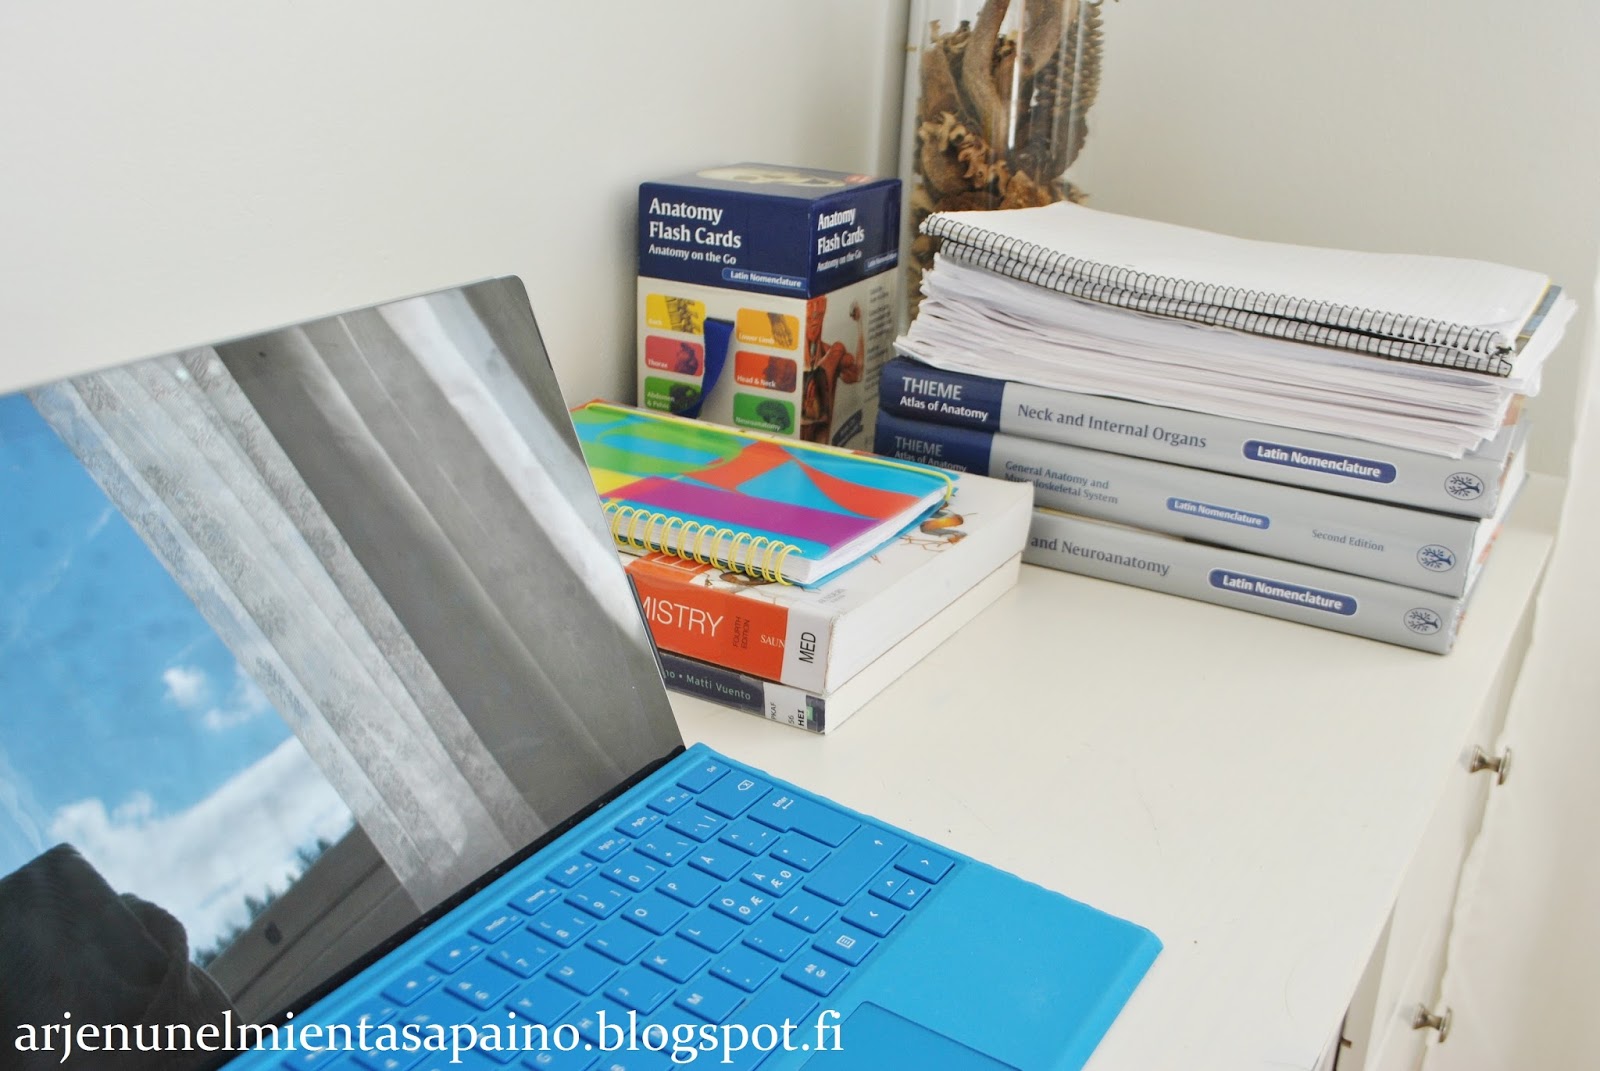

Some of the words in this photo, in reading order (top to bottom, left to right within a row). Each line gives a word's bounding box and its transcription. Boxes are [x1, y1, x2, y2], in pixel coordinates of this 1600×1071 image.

[648, 197, 724, 226] Anatomy
[817, 207, 856, 231] Anatomy
[649, 221, 691, 243] Flash
[695, 227, 742, 249] Cards
[817, 233, 841, 255] Flash
[841, 225, 865, 248] Cards
[648, 244, 690, 260] Anatomy
[691, 251, 704, 261] on
[705, 250, 721, 263] the
[723, 252, 737, 265] Go
[817, 258, 839, 272] Anatomy
[730, 270, 749, 281] Latin
[750, 272, 801, 288] Nomenclature
[739, 332, 758, 342] Lower
[758, 335, 776, 344] Limb
[736, 374, 753, 384] Head
[753, 377, 760, 385] &
[760, 379, 777, 388] Neck
[902, 376, 963, 401] THIEME
[646, 391, 675, 402] Abdomen
[900, 395, 926, 410] Atlas
[927, 400, 940, 412] of
[940, 403, 989, 422] Anatomy
[735, 416, 781, 432] Neuroanatomy
[1017, 403, 1053, 423] Neck
[1056, 406, 1084, 428] and
[1088, 415, 1149, 438] Internal
[1152, 426, 1207, 449] Organs
[894, 435, 943, 457] THIEME
[894, 450, 915, 462] Atlas
[917, 455, 927, 464] of
[927, 457, 967, 473] Anatomy
[1257, 445, 1289, 463] Latin
[1290, 450, 1382, 478] Nomenclature
[1004, 472, 1081, 496] Musloskeletal
[1083, 489, 1119, 504] System
[1005, 460, 1043, 476] General
[1044, 468, 1089, 487] Anatomy
[1090, 479, 1110, 490] and
[1174, 499, 1197, 512] Latin
[1197, 504, 1263, 527] Nomenclature
[1312, 528, 1347, 545] Second
[1348, 536, 1385, 552] Edition
[1030, 535, 1058, 552] and
[1060, 541, 1171, 577] Neuroanatomy
[1222, 574, 1253, 591] Latin
[1254, 580, 1344, 610] Nomenclature
[732, 615, 741, 648] FOURTH
[740, 618, 750, 649] EDITION
[798, 631, 816, 664] MED
[686, 674, 712, 689] Matti
[715, 682, 751, 701] Vuento
[797, 709, 805, 727] HEI
[667, 882, 678, 890] P
[634, 908, 648, 917] O
